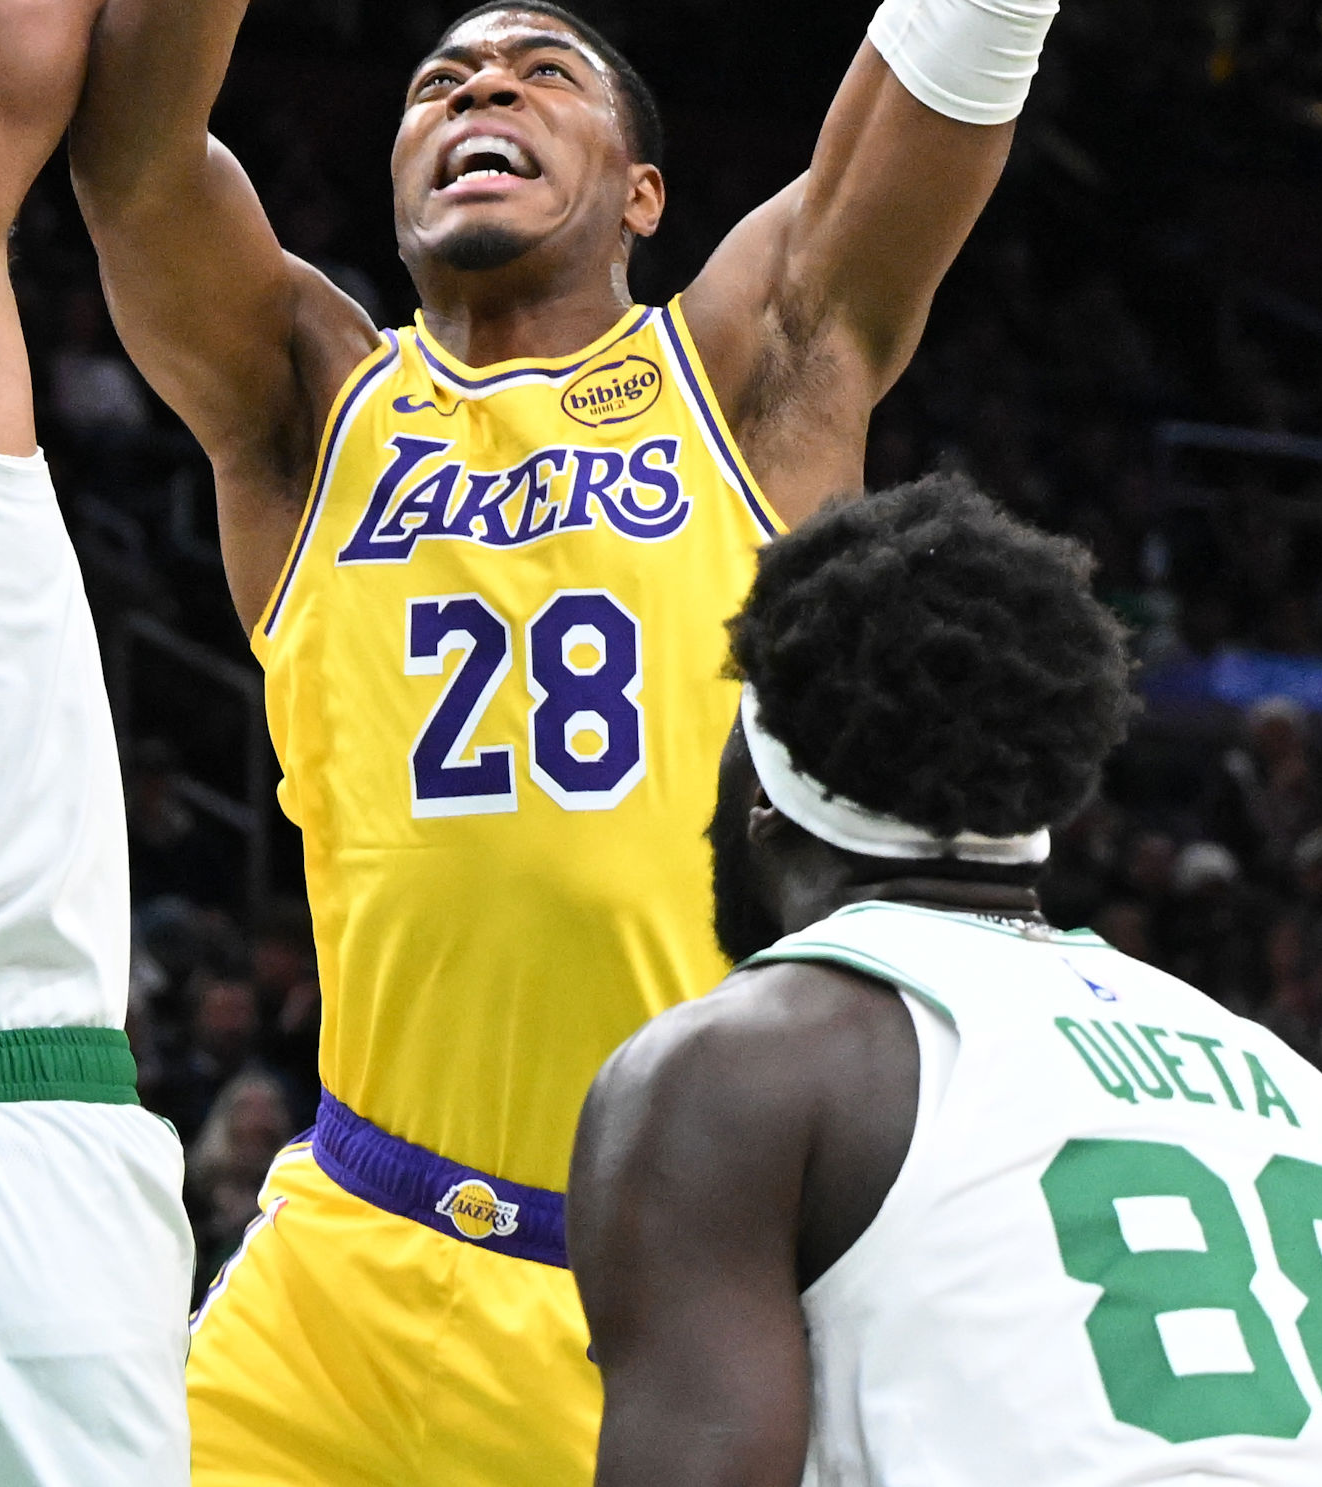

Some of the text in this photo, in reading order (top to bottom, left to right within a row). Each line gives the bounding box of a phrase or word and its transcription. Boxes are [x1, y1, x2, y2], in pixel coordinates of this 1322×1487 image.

[569, 371, 656, 410] bibigo
[335, 432, 694, 568] LAKERS
[404, 588, 648, 819] 28
[1053, 1015, 1303, 1129] QUETA
